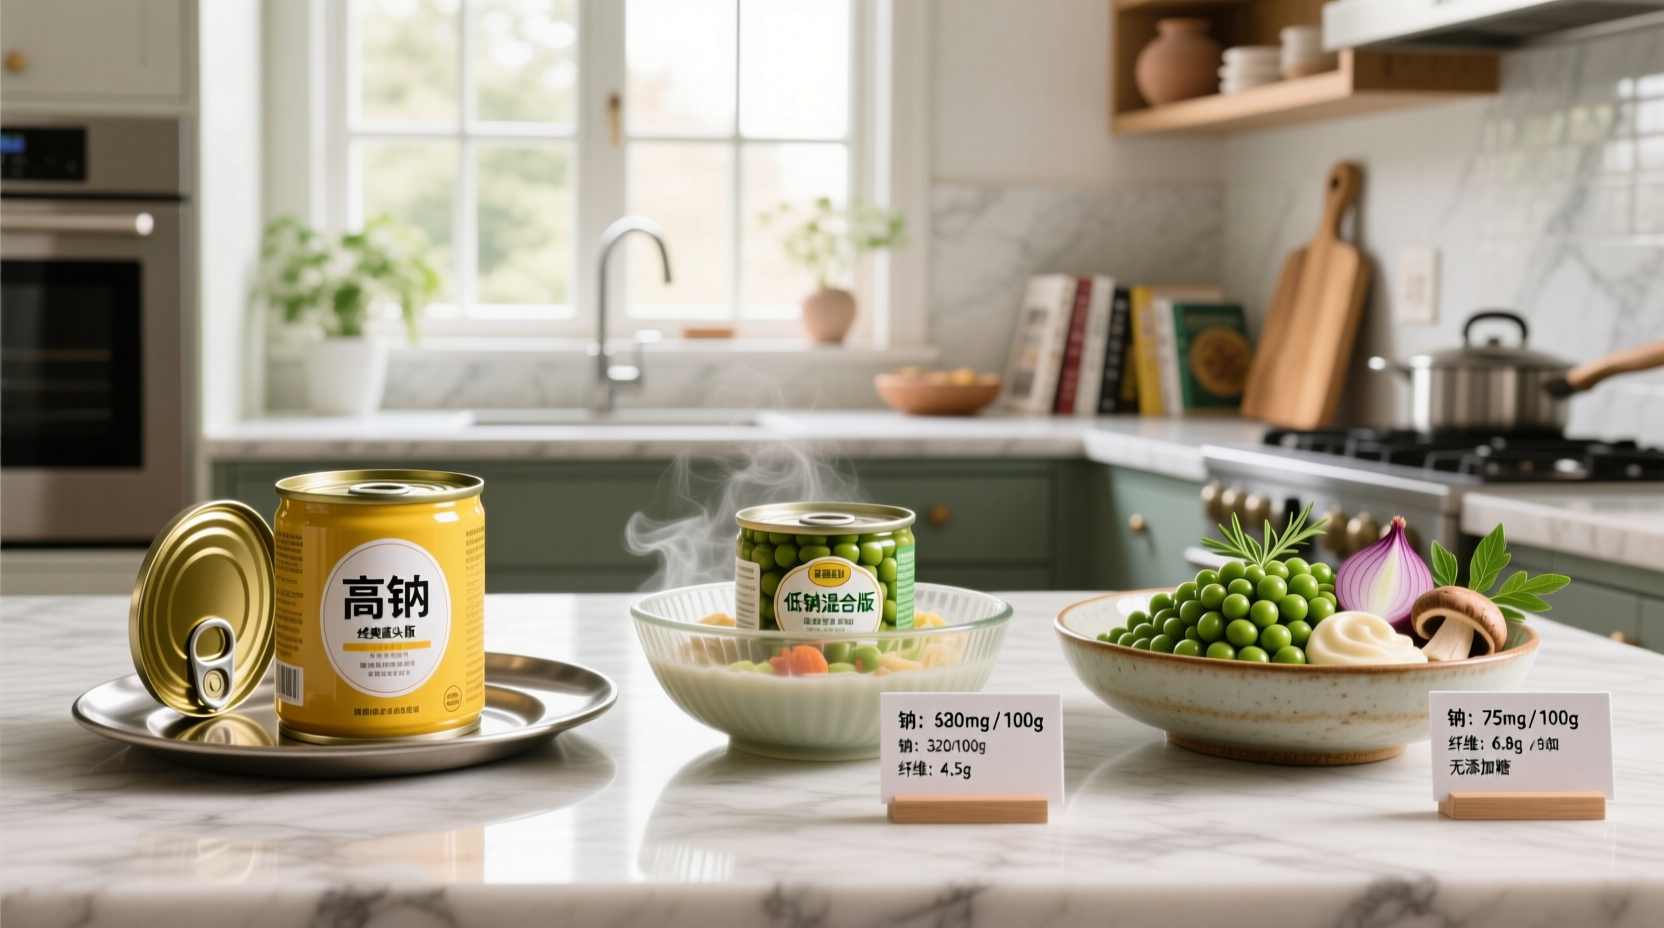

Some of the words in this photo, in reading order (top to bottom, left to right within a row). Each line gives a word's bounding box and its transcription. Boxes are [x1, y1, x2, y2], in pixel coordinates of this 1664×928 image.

[342, 574, 429, 621] 高钠
[1491, 736, 1523, 754] 6.8g
[940, 762, 972, 780] 4.5g
[1450, 758, 1512, 776] 无添加糖
